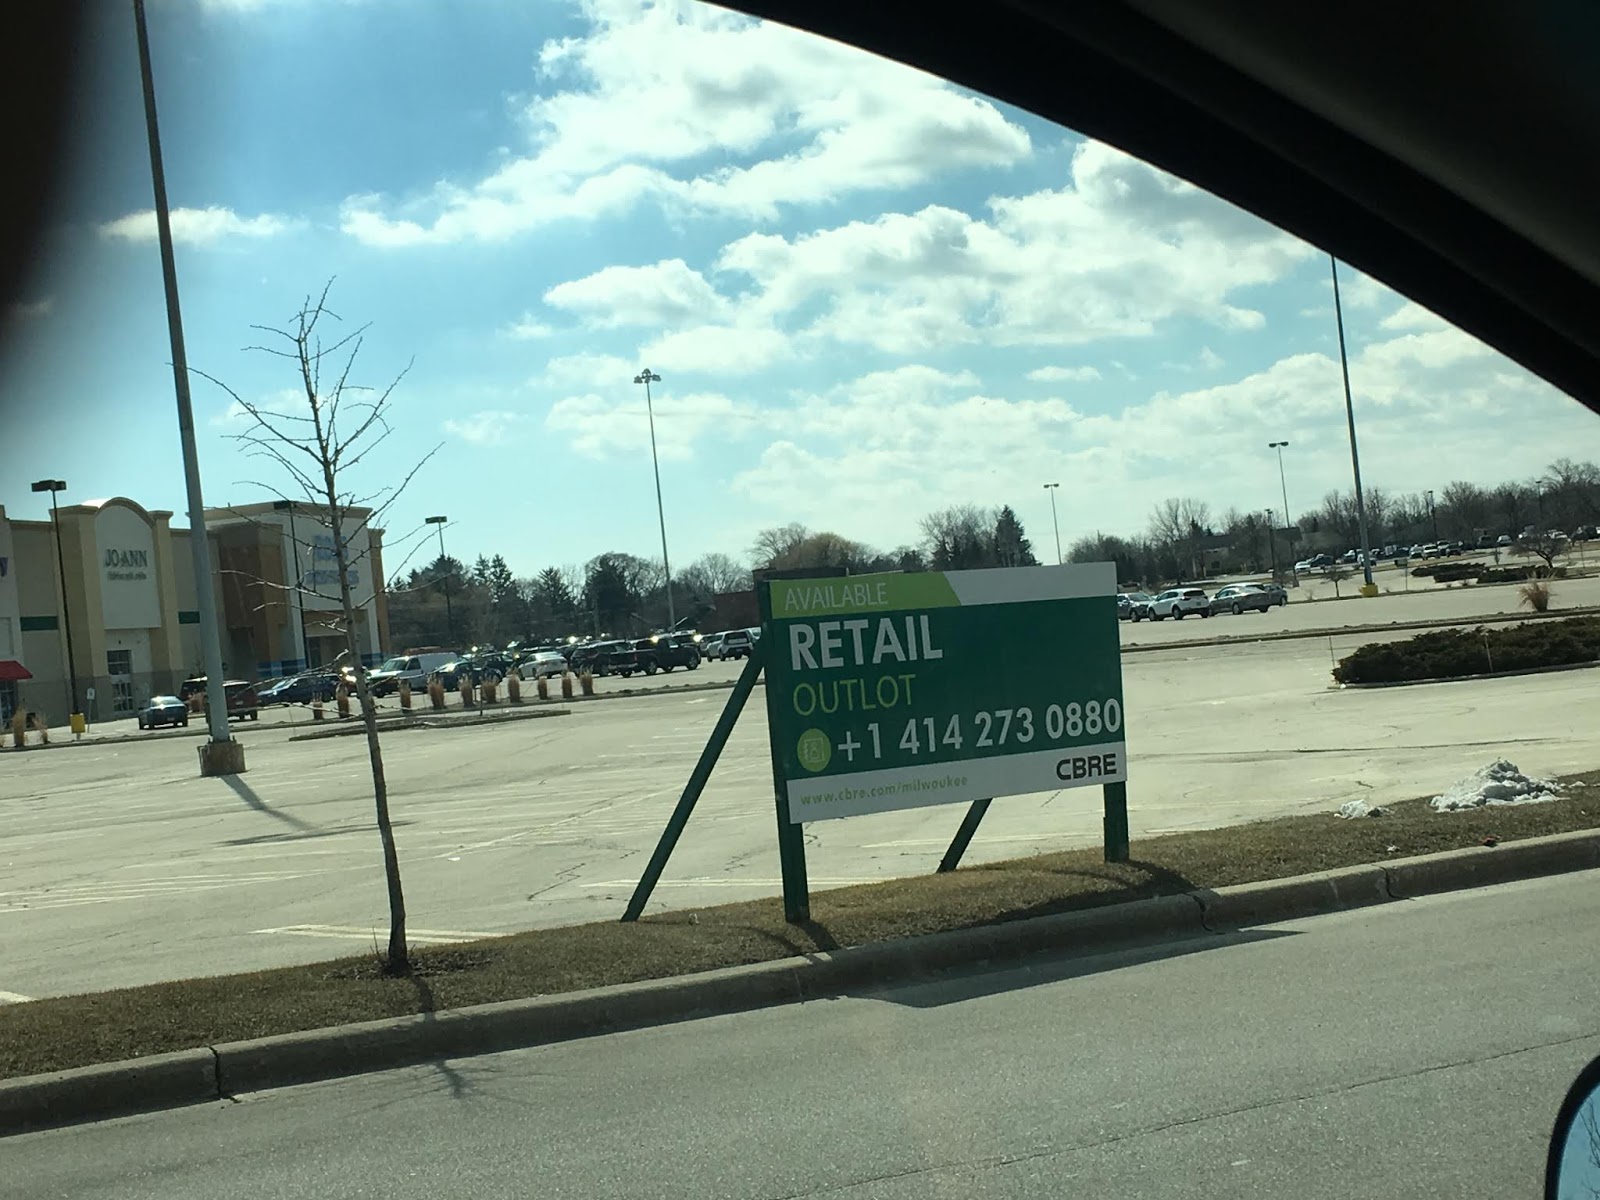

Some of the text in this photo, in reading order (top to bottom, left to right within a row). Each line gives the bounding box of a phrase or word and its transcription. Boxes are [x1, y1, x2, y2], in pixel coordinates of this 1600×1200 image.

[784, 582, 888, 612] AVAILABLE
[789, 614, 944, 671] RETAIL
[793, 674, 917, 716] OUTLOT
[837, 698, 1121, 761] +1 414 273 0880
[1055, 753, 1117, 781] CBRE
[800, 775, 968, 806] www.cbre.com/milwaukee
